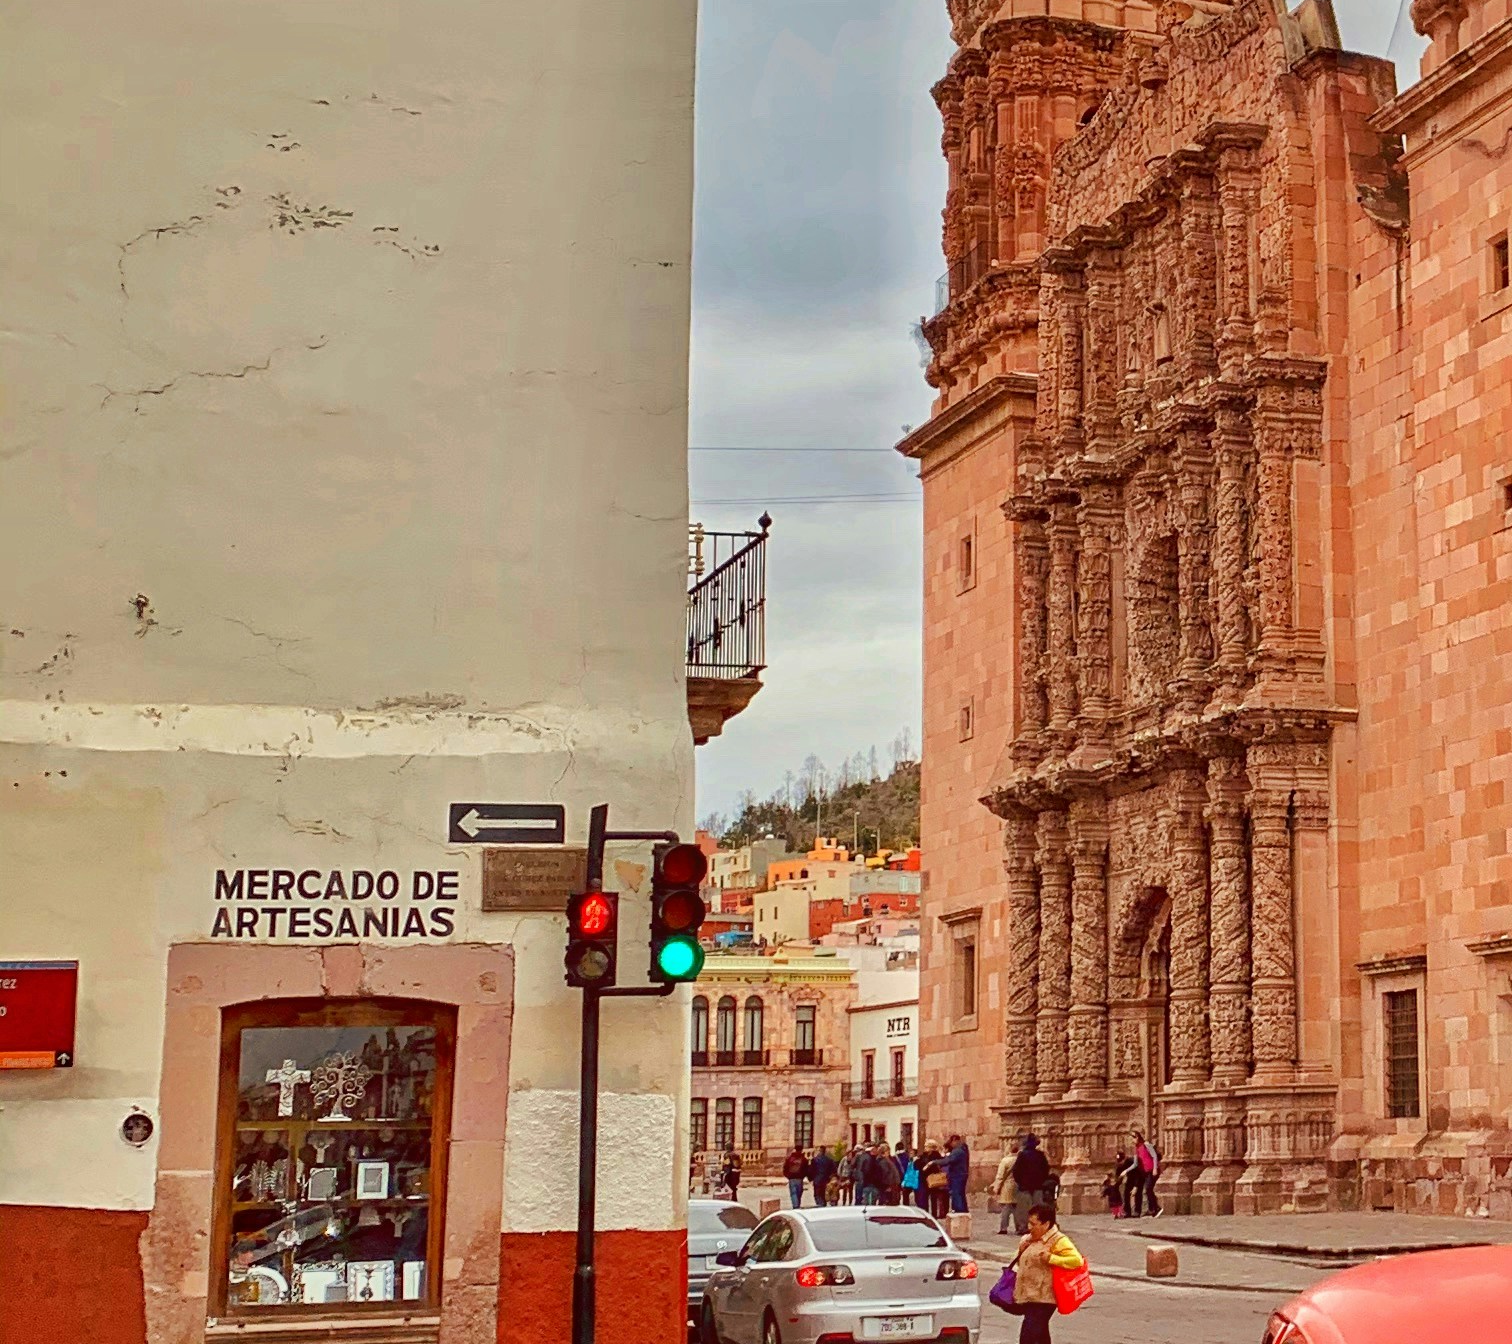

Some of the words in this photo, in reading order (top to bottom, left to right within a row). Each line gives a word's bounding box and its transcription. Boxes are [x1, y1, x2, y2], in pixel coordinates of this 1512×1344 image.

[214, 869, 399, 900] MERCADO
[412, 871, 459, 901] DE
[211, 906, 455, 938] ARTESANIAS
[887, 1017, 910, 1032] NTR
